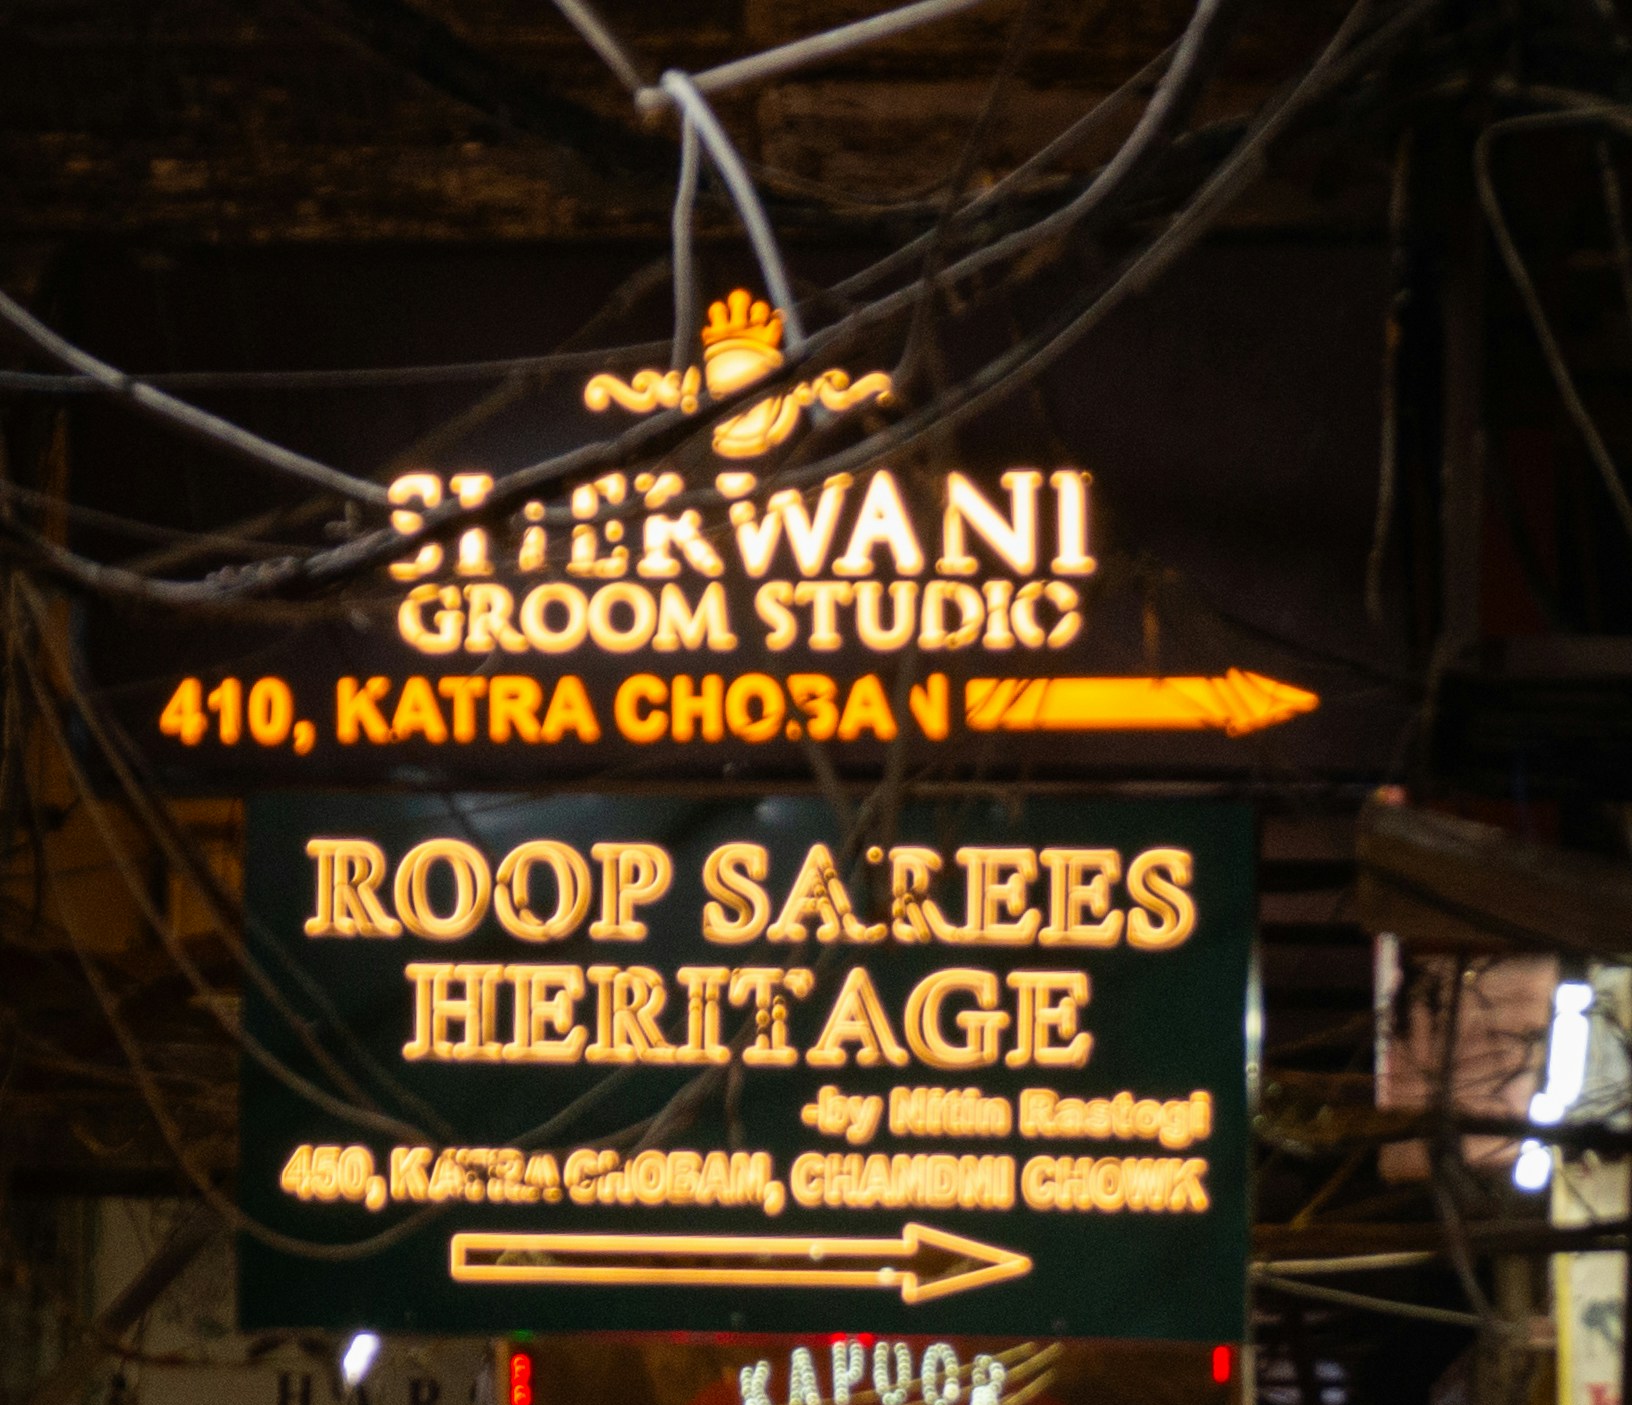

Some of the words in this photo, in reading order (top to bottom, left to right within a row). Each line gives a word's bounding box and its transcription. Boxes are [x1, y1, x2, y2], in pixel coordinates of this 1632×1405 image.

[397, 581, 738, 654] GROOM
[755, 578, 1083, 652] STUDIO
[158, 676, 317, 757] 410,
[334, 674, 602, 745] KATRA
[304, 838, 672, 942] ROOP
[701, 842, 1197, 949] SAREES
[403, 962, 1095, 1070] HERITAGE
[889, 1085, 1012, 1137] Nitin
[1018, 1087, 1212, 1150] Rastogi
[280, 1144, 387, 1212] 450,
[390, 1146, 562, 1203] KATRA
[791, 1151, 1016, 1208] CHANDNI
[1021, 1154, 1210, 1212] CHOWK
